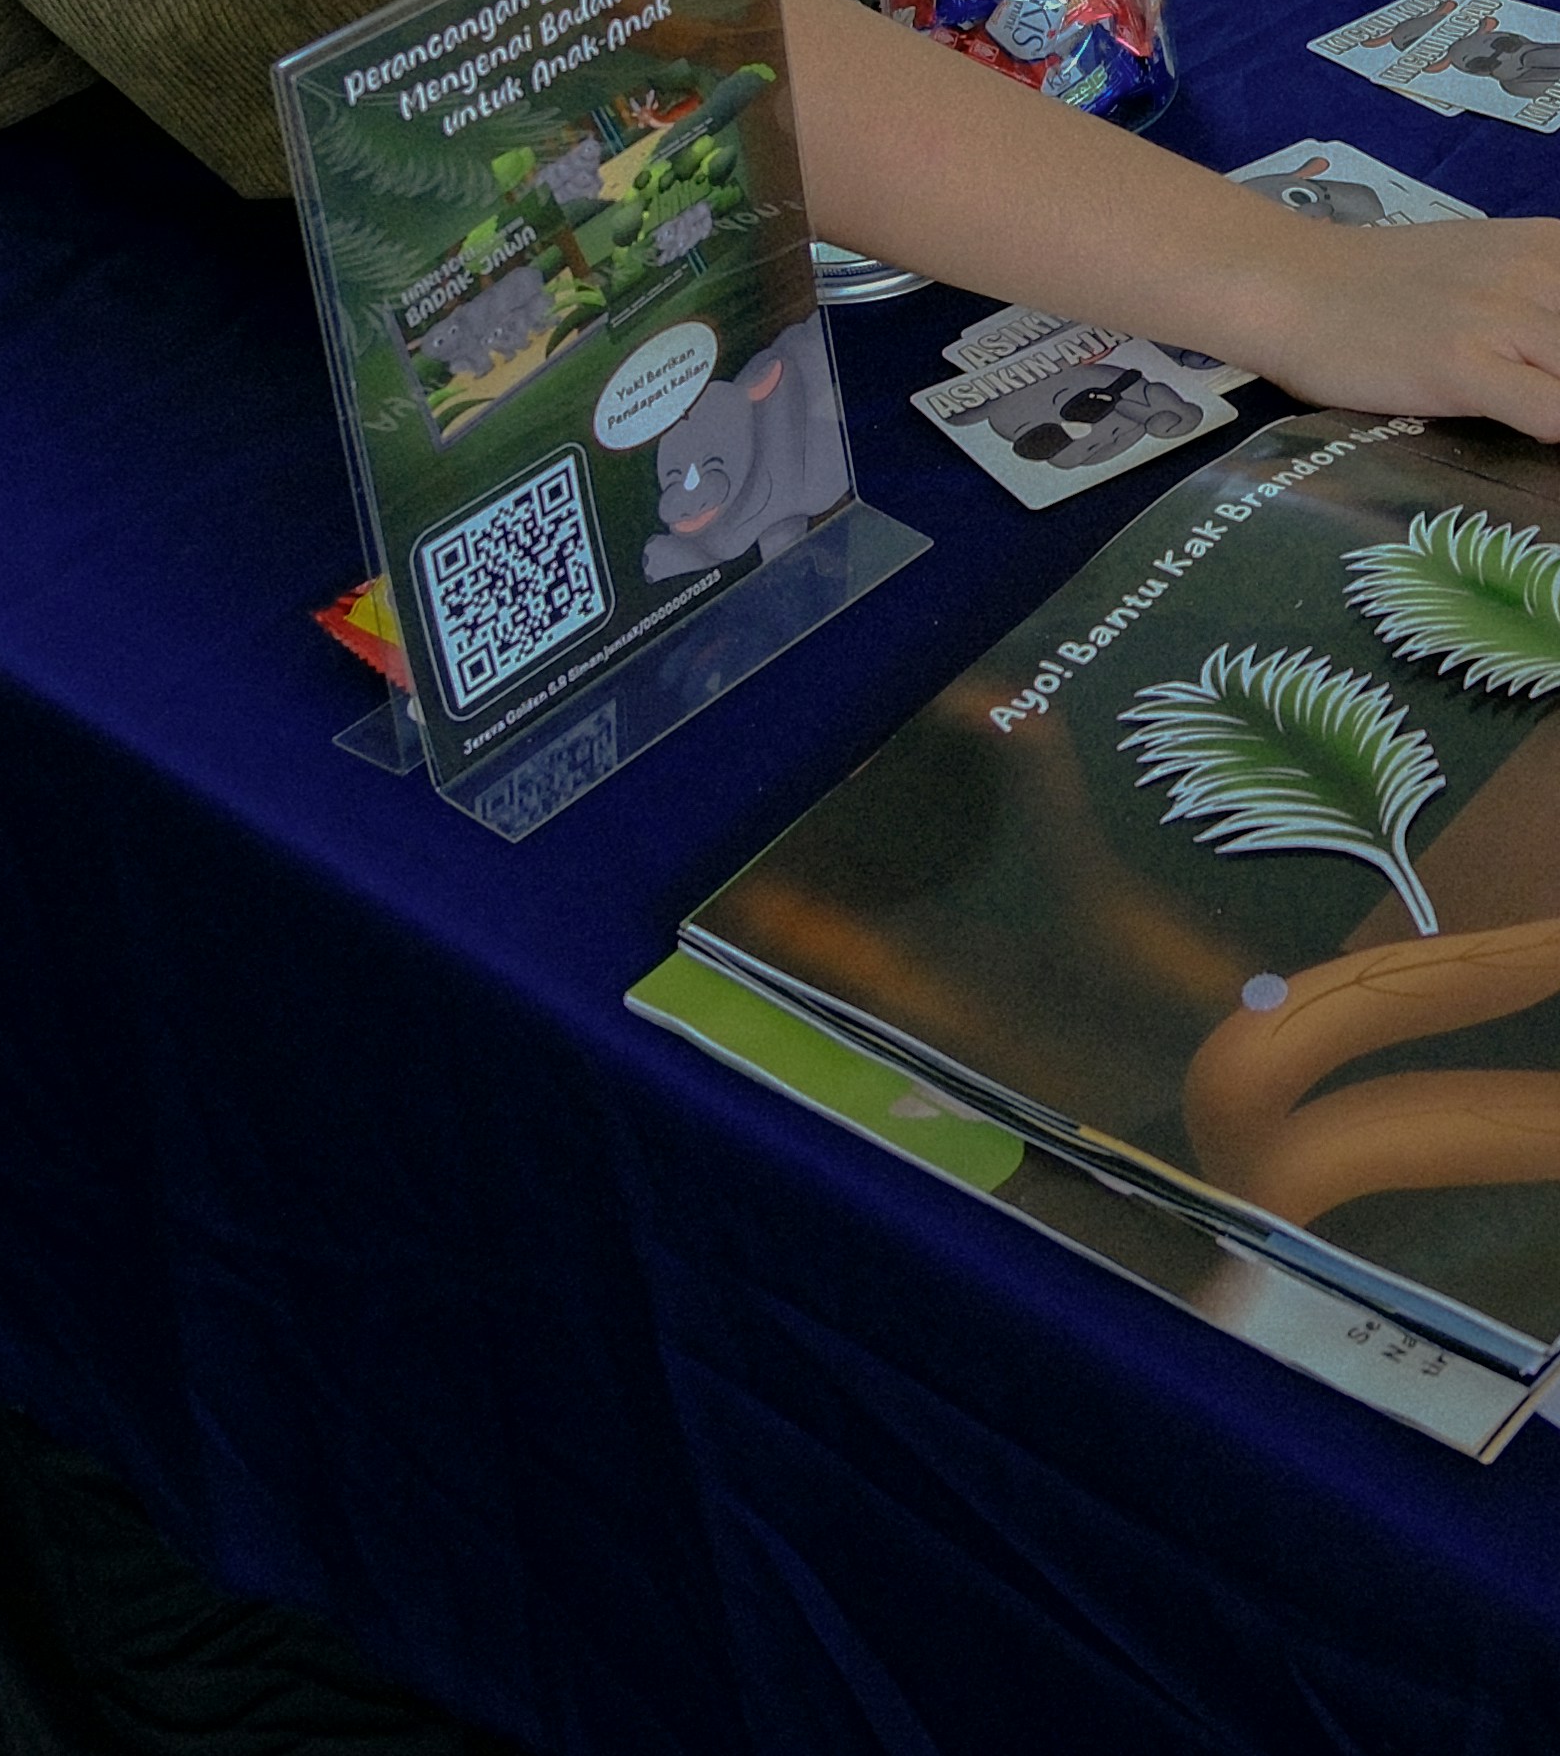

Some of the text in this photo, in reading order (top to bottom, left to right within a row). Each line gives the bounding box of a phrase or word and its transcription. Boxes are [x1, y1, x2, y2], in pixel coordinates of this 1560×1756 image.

[398, 26, 533, 121] Mengenai
[443, 75, 524, 137] untuk
[404, 269, 475, 328] BADAK
[480, 224, 538, 275] JAWA
[607, 359, 711, 430] Pendapat Kalian
[646, 347, 697, 385] Berikan
[927, 325, 1133, 420] ASIKIN AJA
[989, 659, 1074, 733] Ayo!
[1055, 575, 1169, 666] Bantu
[1153, 519, 1228, 578] Kak
[1214, 439, 1357, 523] Brandon
